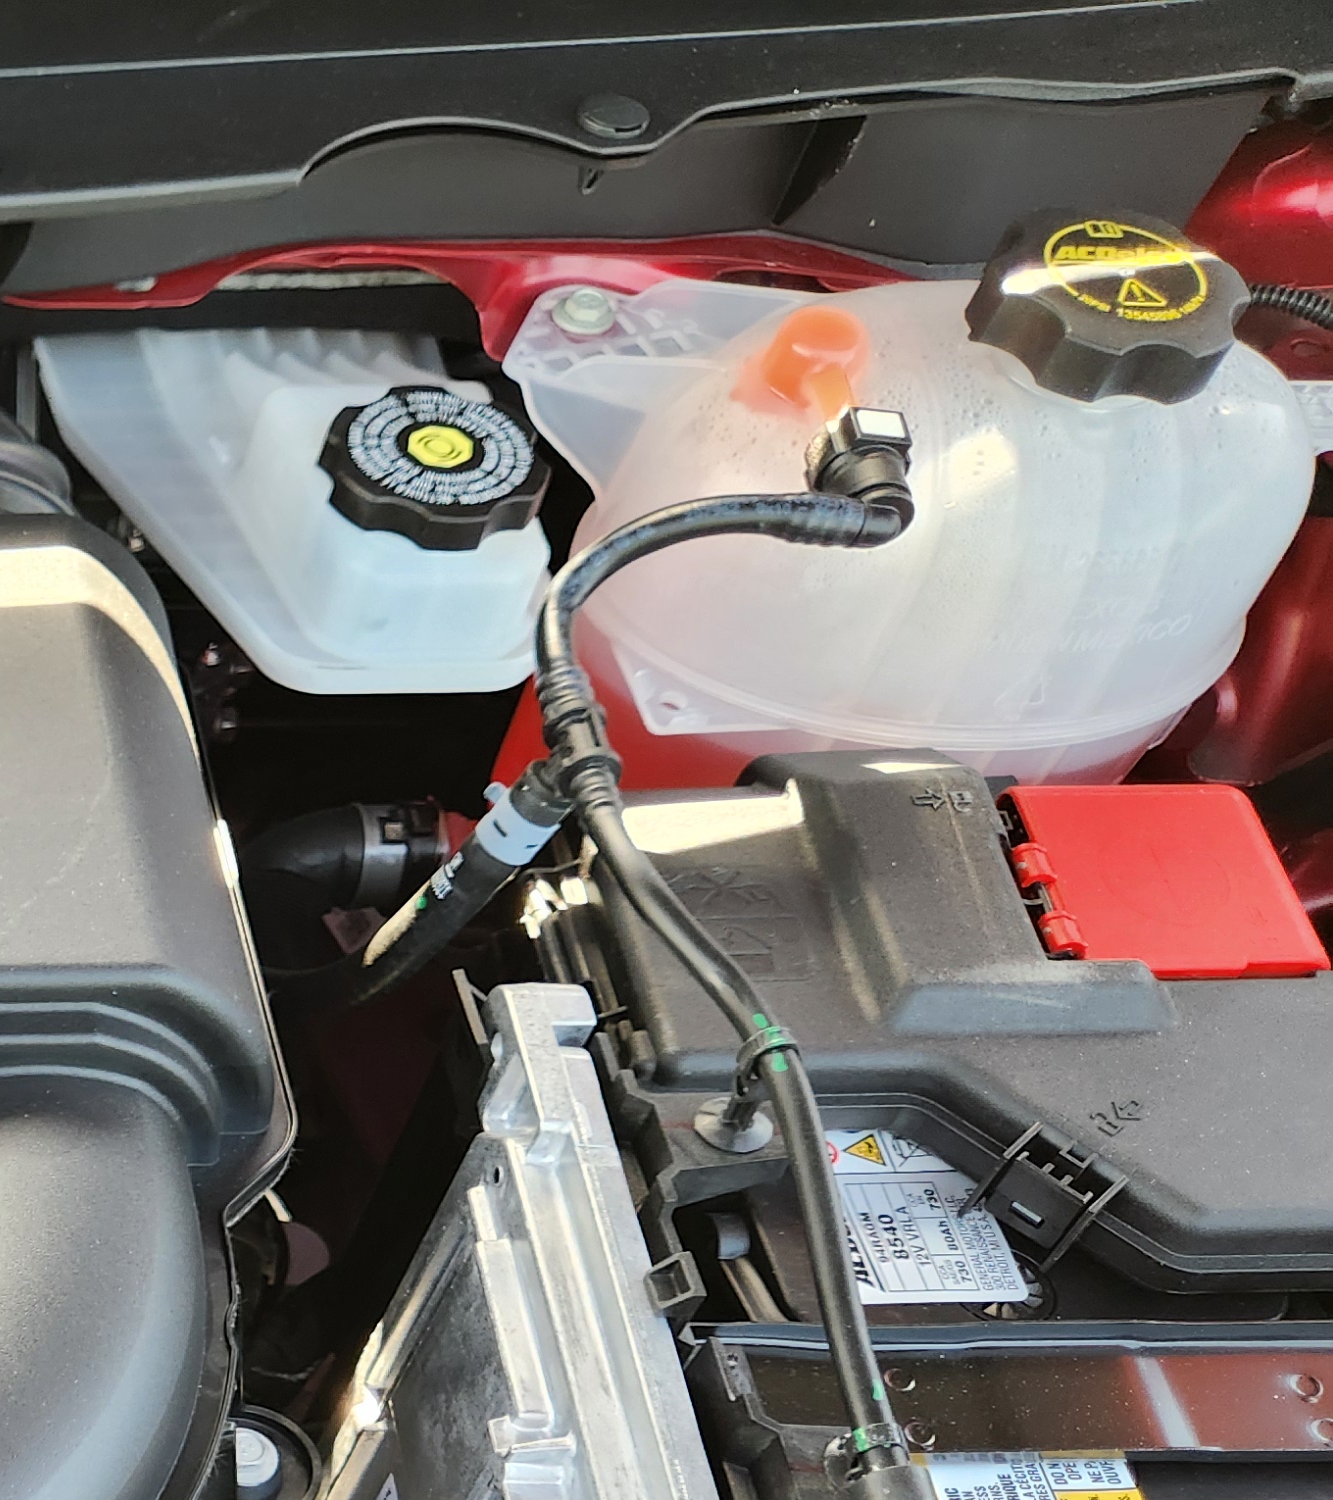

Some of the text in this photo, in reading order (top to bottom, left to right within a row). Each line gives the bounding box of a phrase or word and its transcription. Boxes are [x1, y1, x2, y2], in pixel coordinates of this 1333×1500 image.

[924, 1189, 941, 1211] 730
[878, 1214, 909, 1259] 8540
[896, 1206, 931, 1267] 12V VRLA
[938, 1221, 959, 1251] 80Ah
[964, 1216, 999, 1274] RENAISSANCE
[956, 1261, 972, 1282] 730
[969, 1253, 994, 1291] GENERAL
[991, 1275, 1006, 1290] 300
[997, 1252, 1019, 1290] DETROIT,
[1051, 1471, 1068, 1484] DO
[1085, 1469, 1104, 1483] NE
